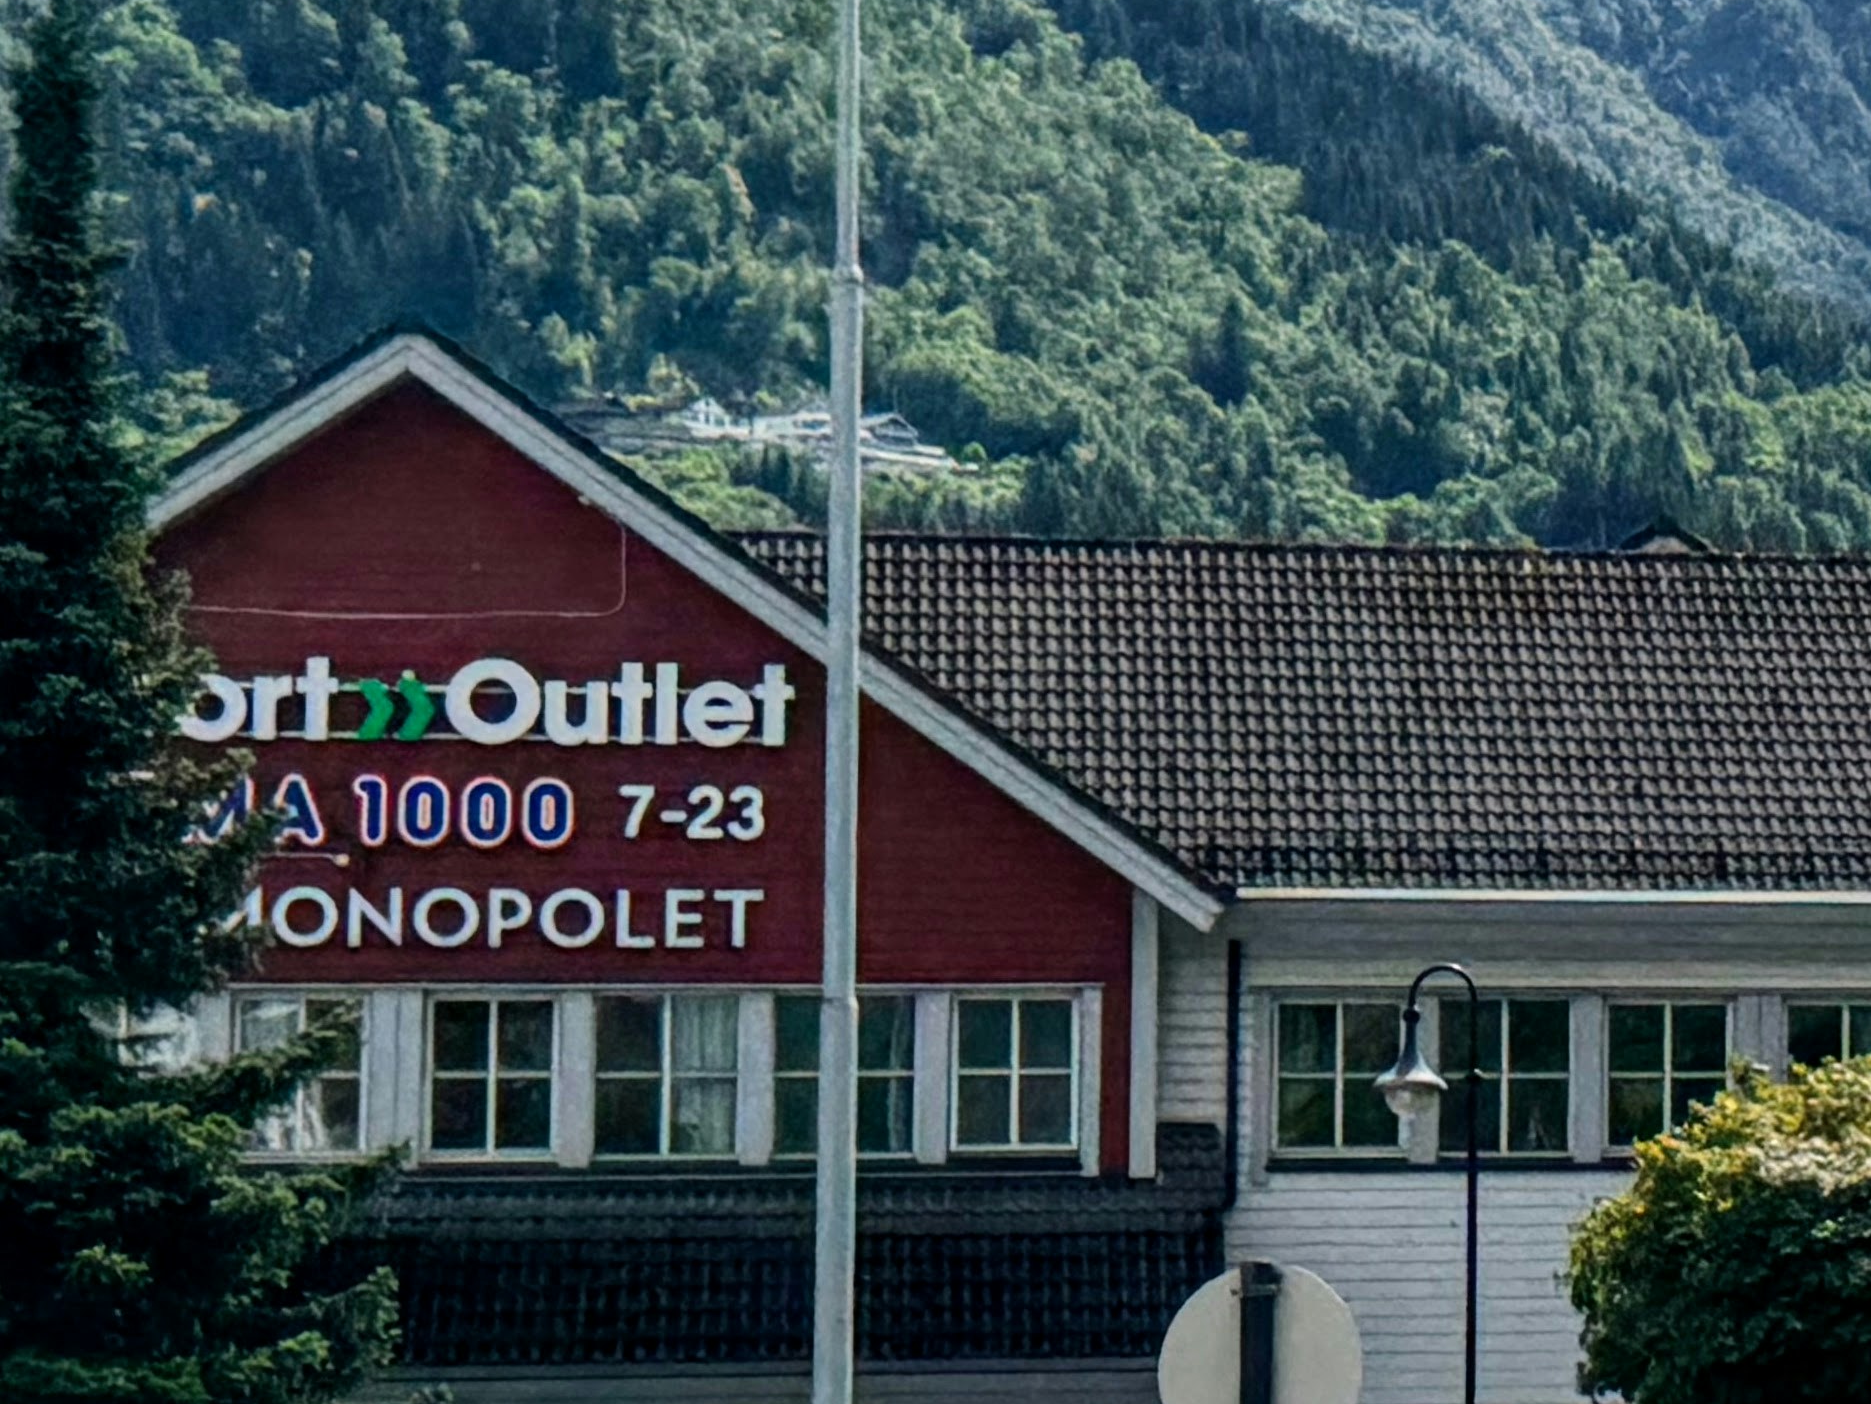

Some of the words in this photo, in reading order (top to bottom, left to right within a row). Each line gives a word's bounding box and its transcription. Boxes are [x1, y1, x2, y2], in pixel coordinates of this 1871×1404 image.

[445, 657, 796, 748] Outlet
[353, 773, 575, 848] 1000
[619, 784, 766, 841] 7-23
